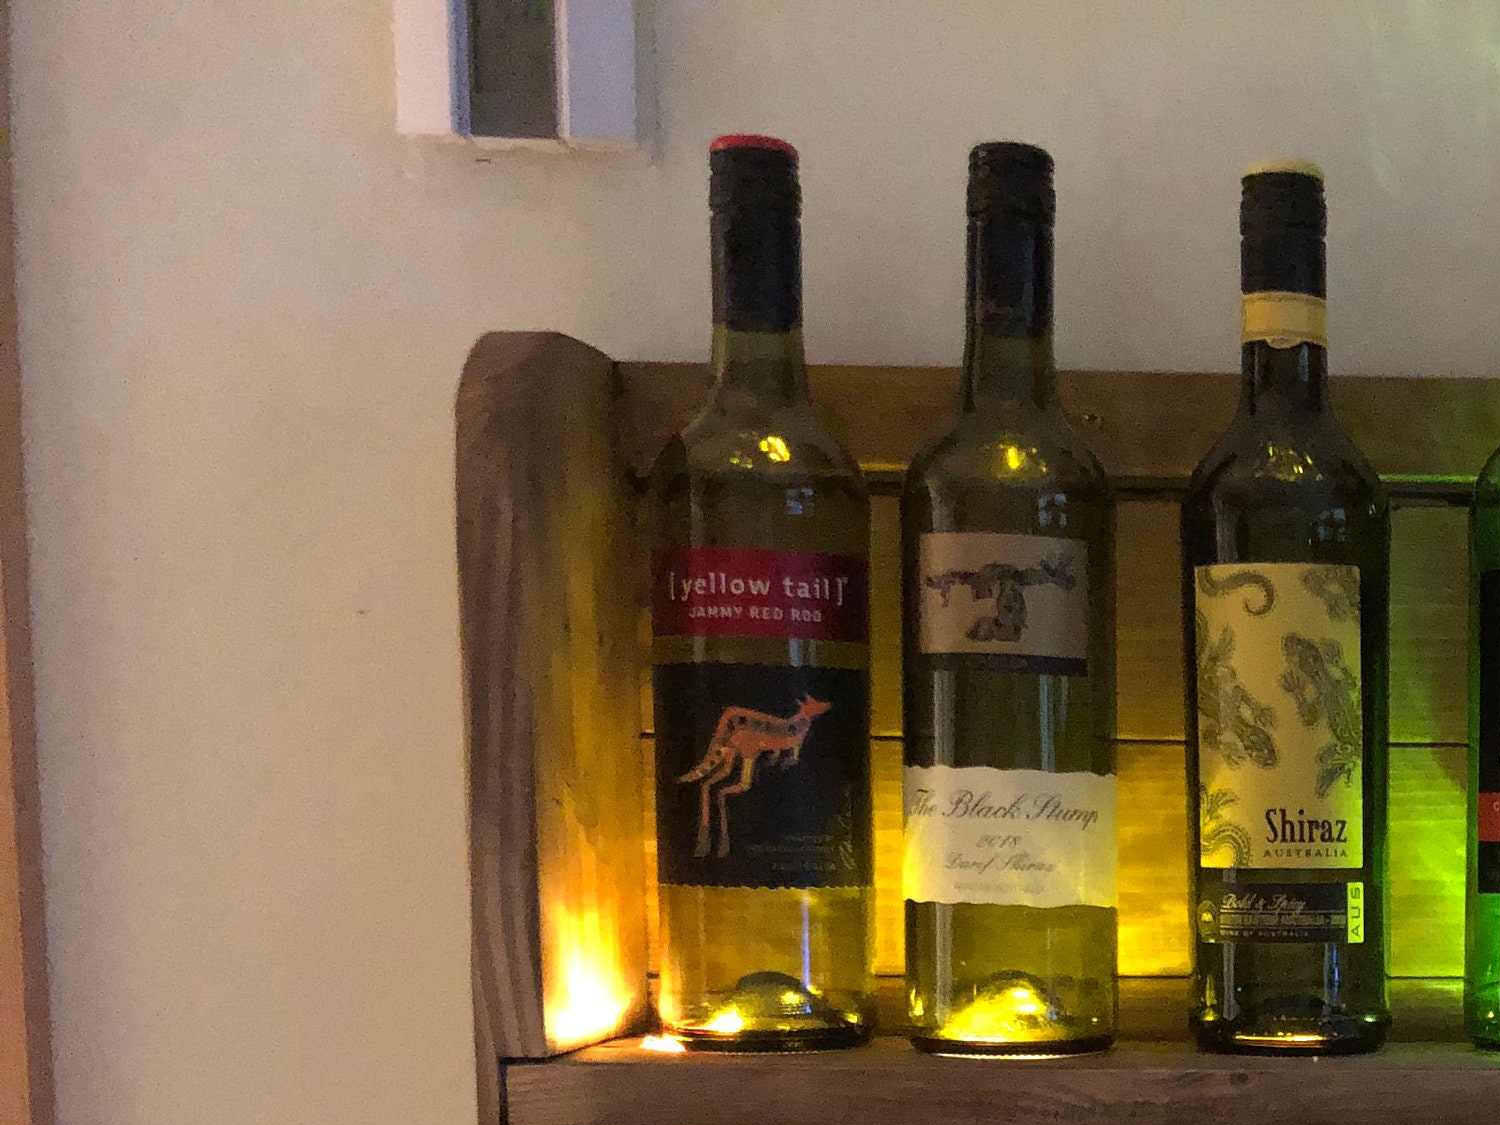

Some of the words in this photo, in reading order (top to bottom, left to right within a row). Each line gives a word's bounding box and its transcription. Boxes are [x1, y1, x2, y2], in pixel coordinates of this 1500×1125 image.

[689, 606, 743, 619] JAMMY
[750, 607, 784, 621] RED
[791, 607, 822, 622] ROO
[911, 788, 937, 816] The
[942, 789, 1029, 820] Black
[1025, 792, 1099, 831] Stump
[1265, 808, 1347, 844] Shiraz
[1263, 847, 1348, 858] AUSTRALIA
[1350, 887, 1360, 937] AUS
